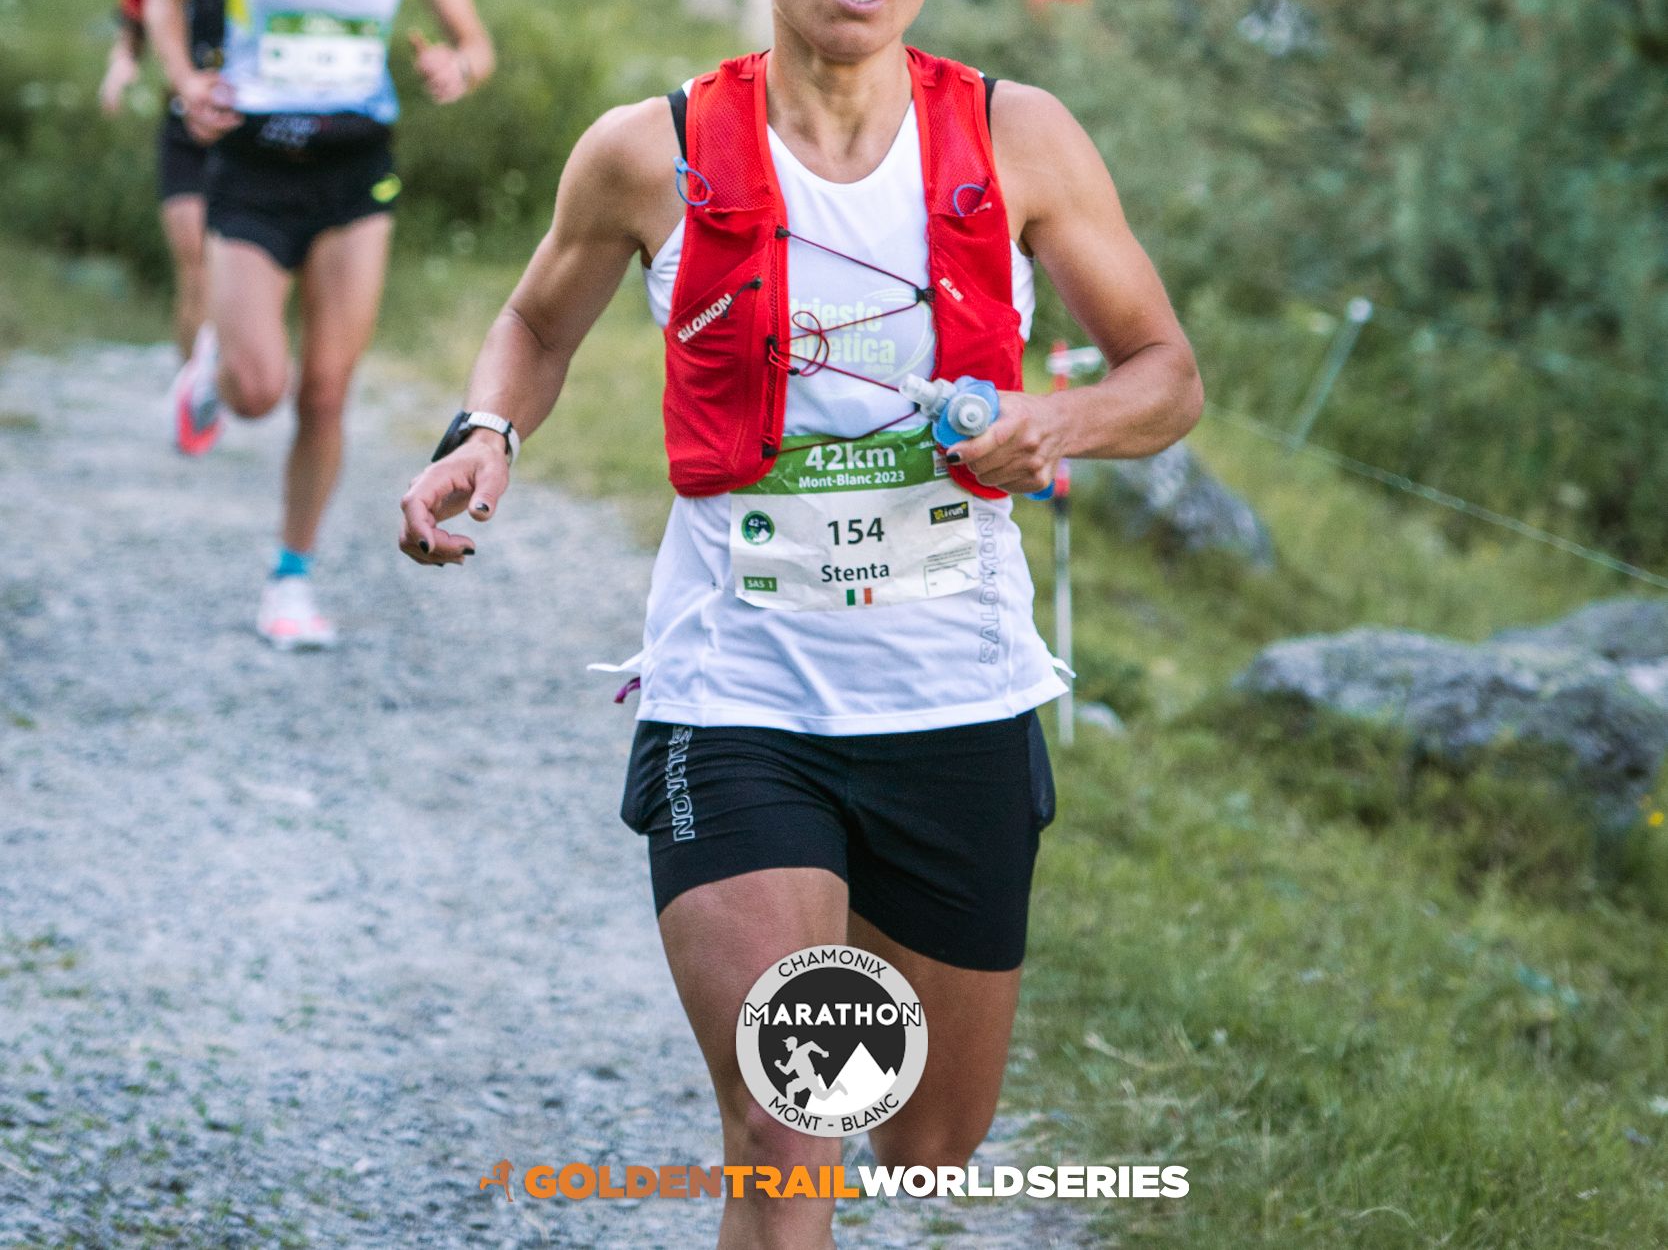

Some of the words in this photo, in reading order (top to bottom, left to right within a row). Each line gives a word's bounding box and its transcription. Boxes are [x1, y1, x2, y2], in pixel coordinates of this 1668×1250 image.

[805, 443, 896, 471] 42km
[798, 473, 872, 488] Mont-Blanc
[874, 470, 906, 484] 2023
[827, 517, 885, 546] 154
[747, 579, 765, 588] SAS
[821, 563, 890, 583] Stenta
[977, 512, 1001, 666] SALOMON
